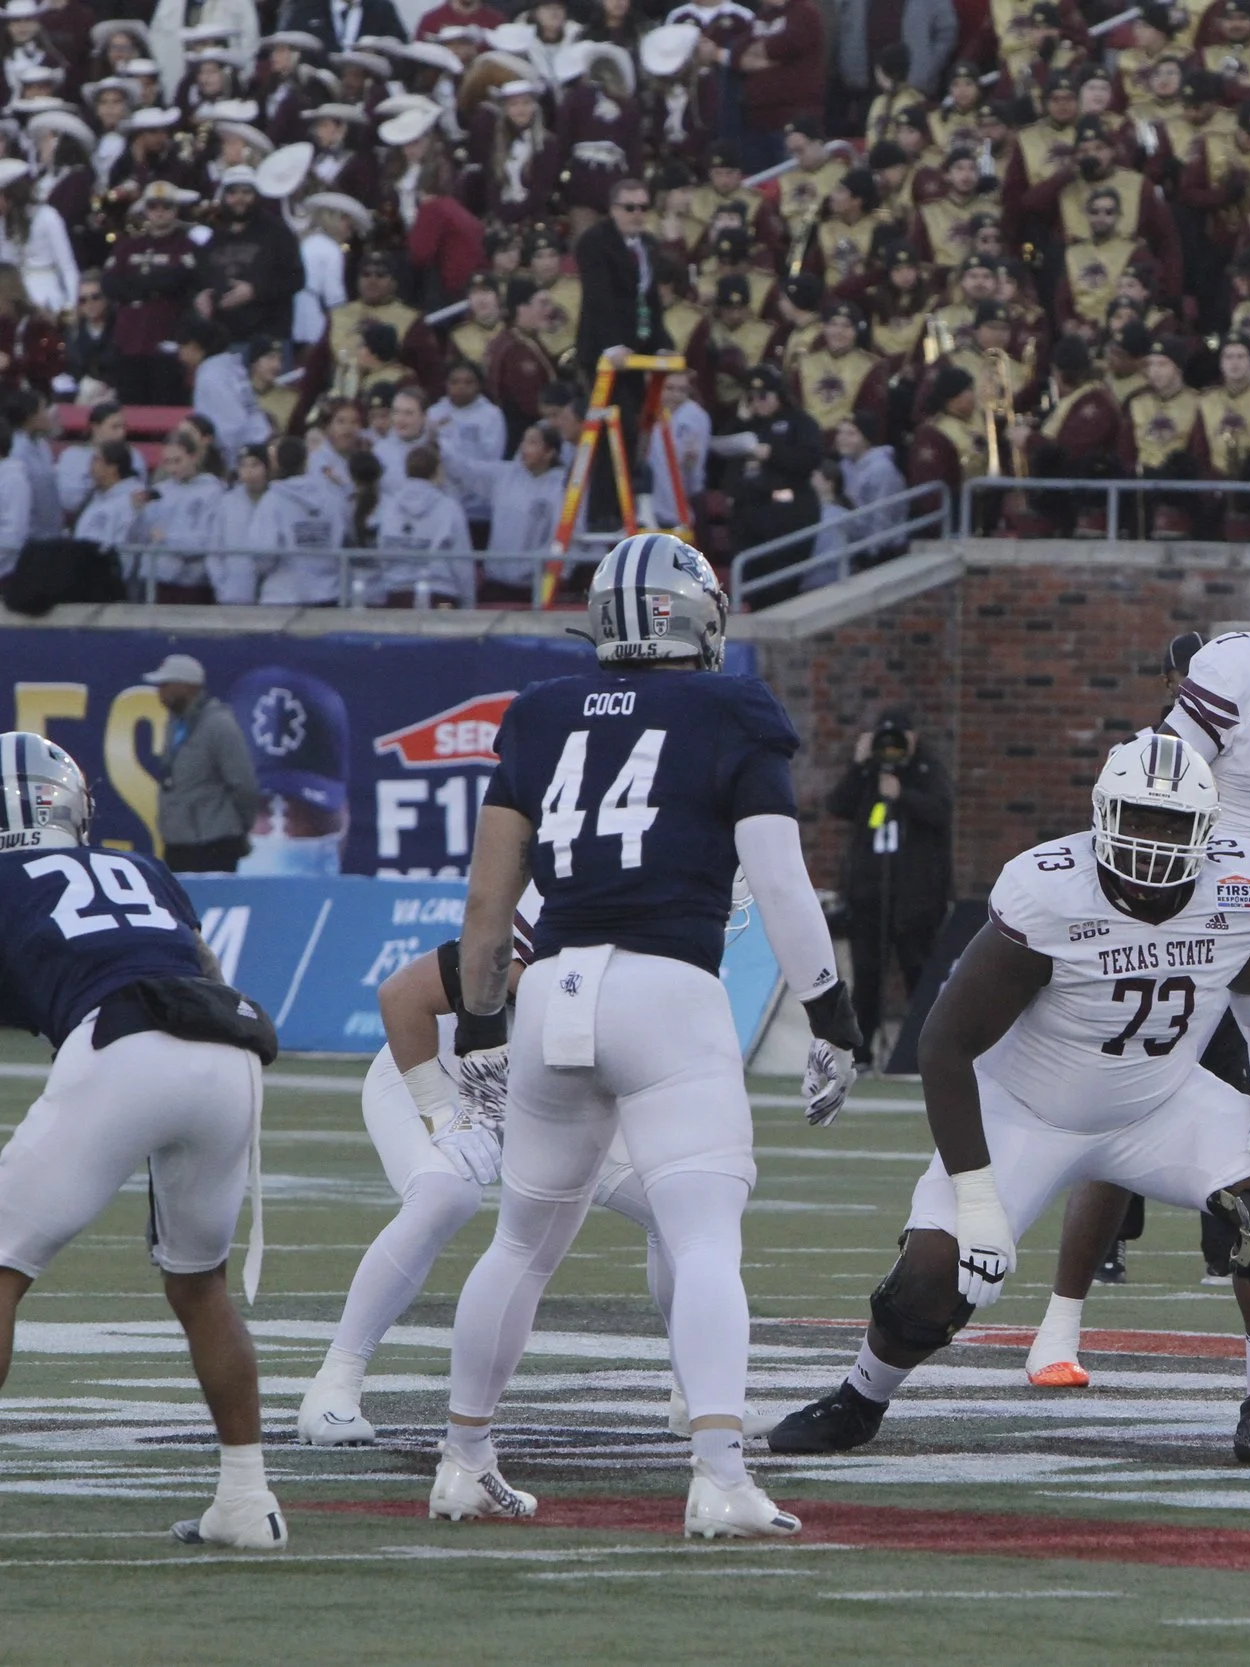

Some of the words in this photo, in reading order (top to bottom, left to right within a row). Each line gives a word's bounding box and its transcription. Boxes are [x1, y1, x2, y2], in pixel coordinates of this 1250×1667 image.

[615, 643, 657, 658] OWLS
[583, 691, 637, 717] COCO
[537, 729, 667, 879] 44
[0, 831, 41, 850] OWLS
[1033, 847, 1075, 871] 73
[23, 853, 178, 940] 29
[1069, 919, 1110, 941] SBC
[1205, 922, 1229, 930] adidas
[1099, 942, 1159, 976] TEXAS
[1166, 938, 1215, 967] STATE
[1101, 976, 1196, 1057] 73
